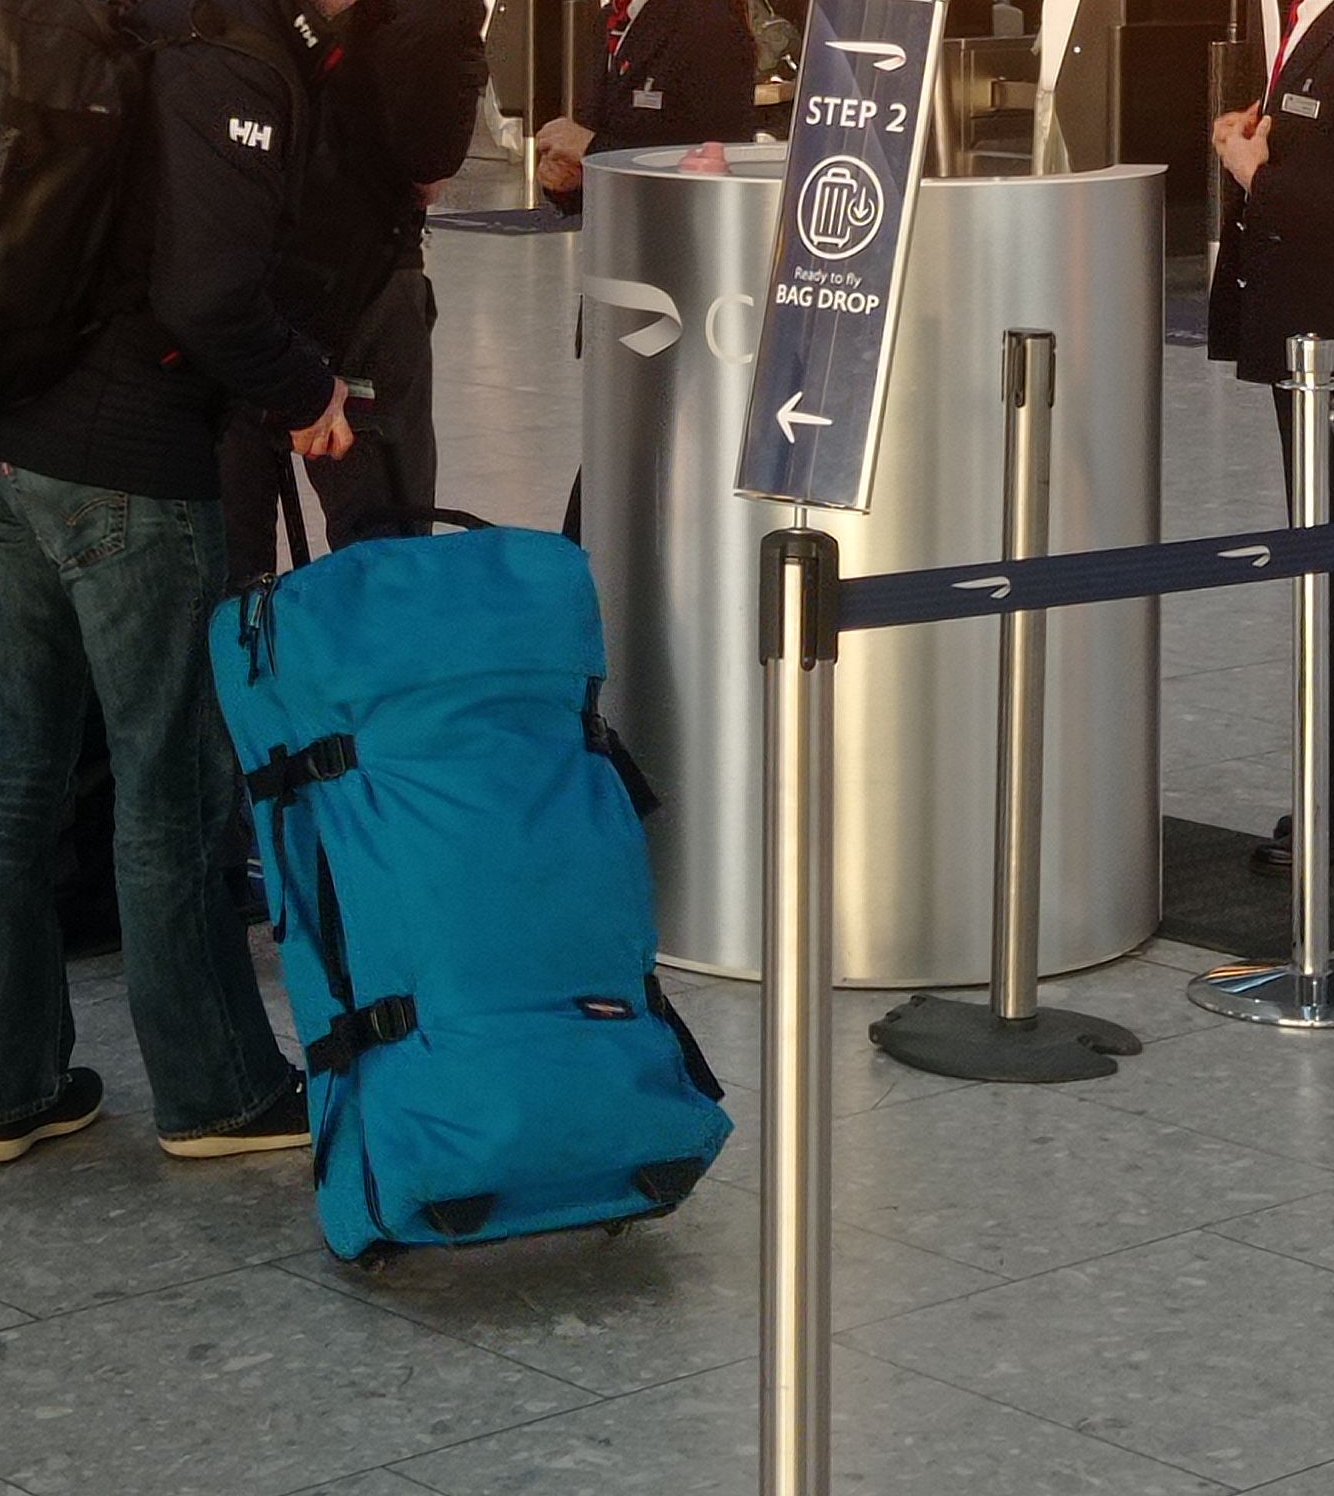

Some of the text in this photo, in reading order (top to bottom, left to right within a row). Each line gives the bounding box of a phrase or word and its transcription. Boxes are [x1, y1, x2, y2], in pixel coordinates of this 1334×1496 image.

[805, 95, 908, 133] STEP 2
[229, 117, 272, 152] HH
[794, 265, 863, 289] Ready to fly
[775, 284, 880, 315] BAG DROP
